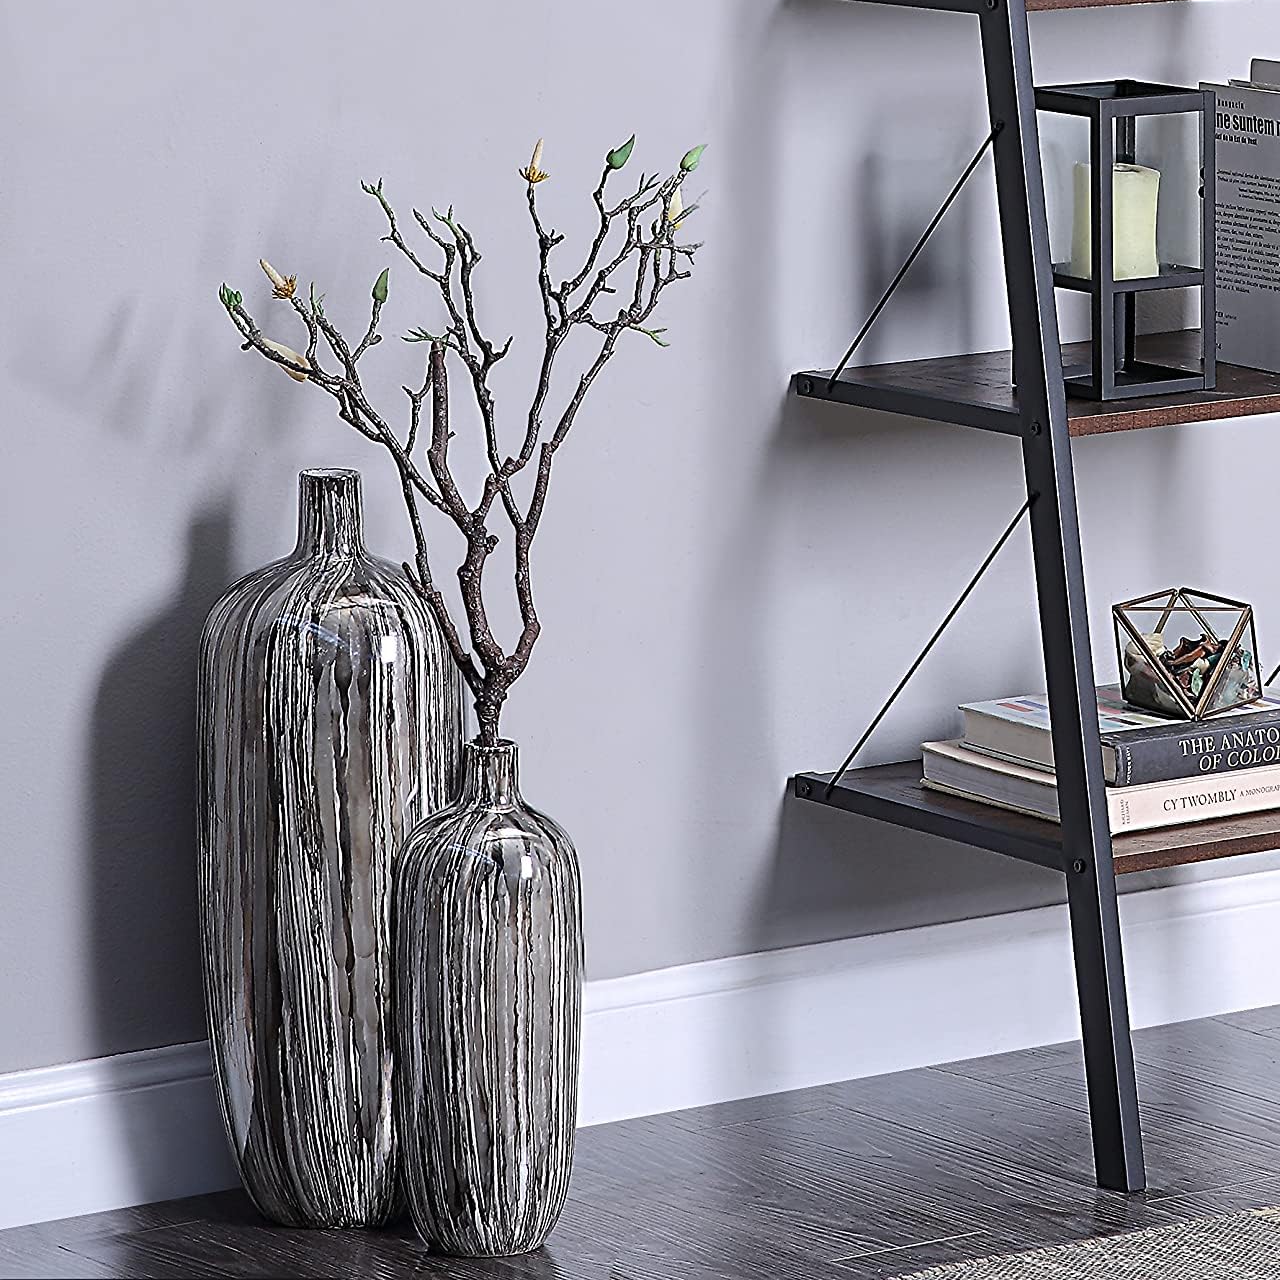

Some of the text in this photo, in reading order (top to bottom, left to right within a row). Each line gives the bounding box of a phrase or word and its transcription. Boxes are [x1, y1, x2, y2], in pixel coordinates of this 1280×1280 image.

[1232, 113, 1275, 136] suntem
[1178, 734, 1216, 757] THE
[1199, 754, 1223, 772] OF
[1163, 798, 1178, 812] CY
[1180, 788, 1238, 810] TWOMBLY
